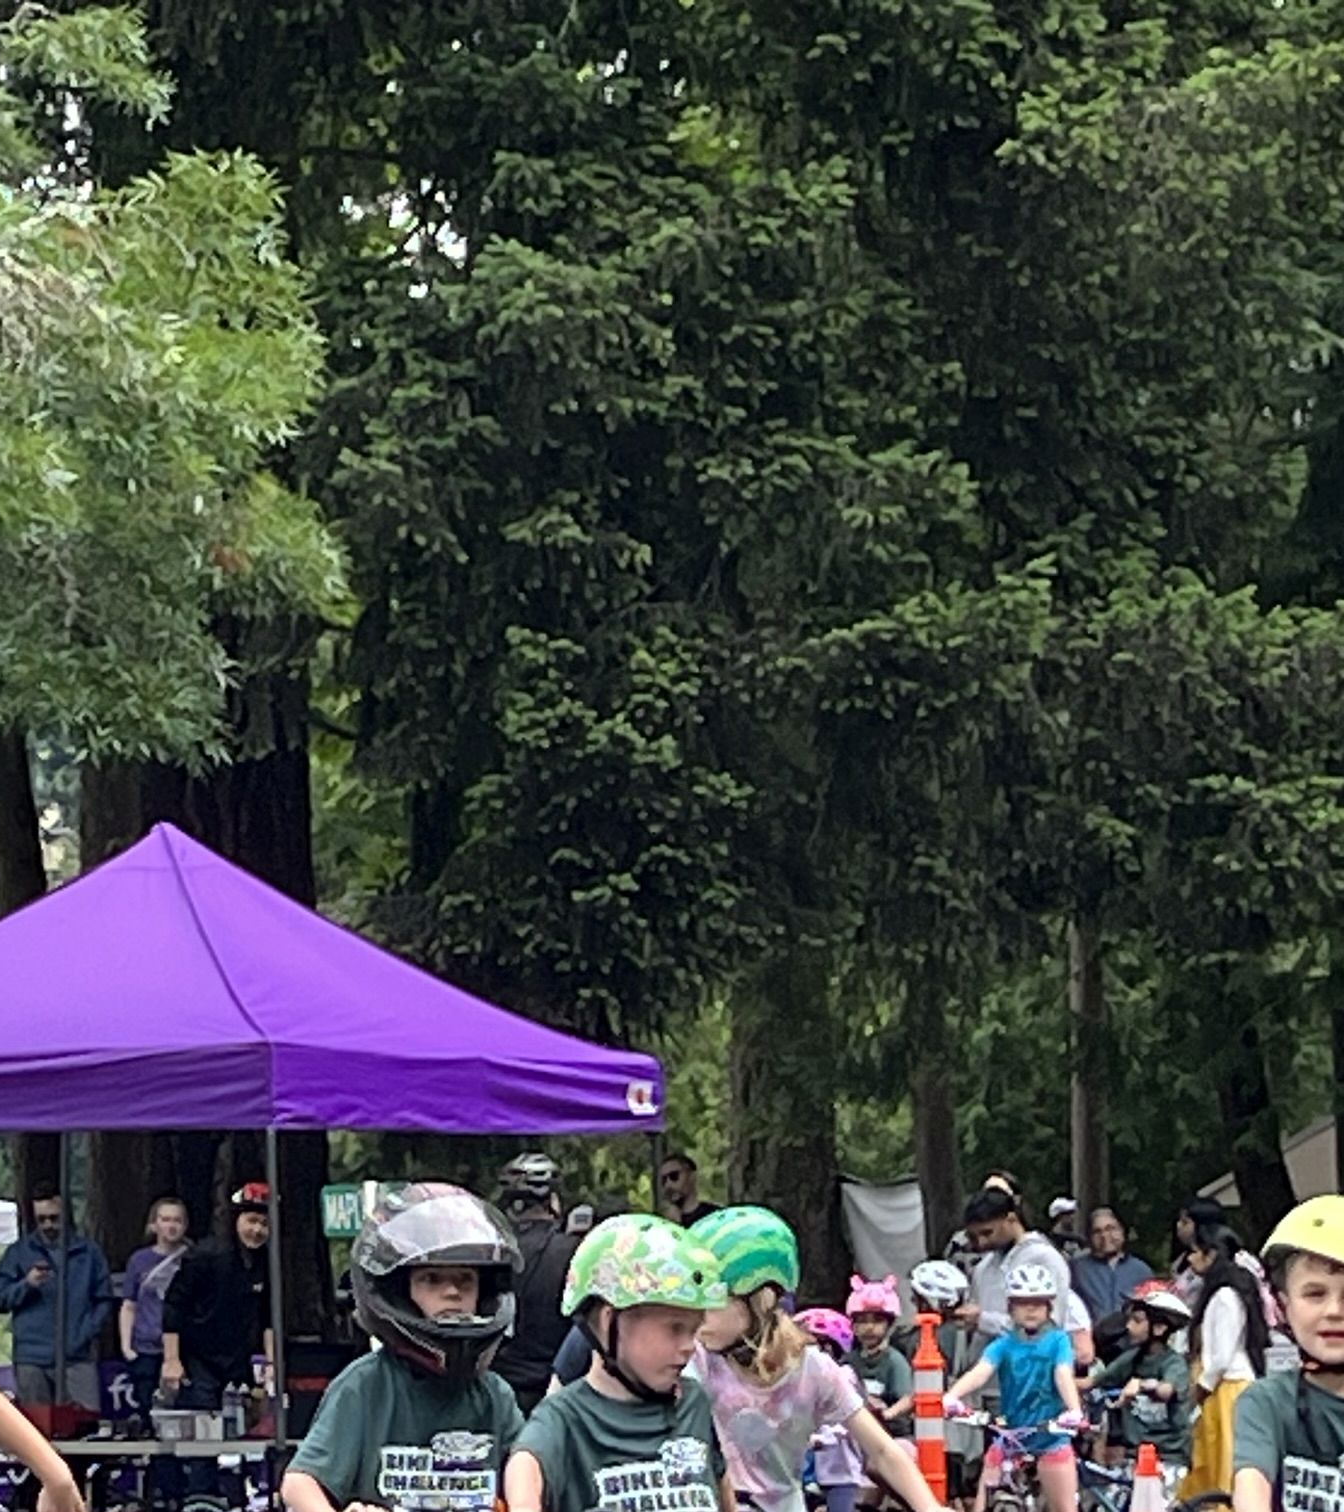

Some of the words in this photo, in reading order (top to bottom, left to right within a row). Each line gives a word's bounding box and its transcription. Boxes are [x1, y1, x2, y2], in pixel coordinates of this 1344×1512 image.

[324, 1192, 363, 1231] MAPL
[602, 1468, 666, 1497] BIKE
[1283, 1463, 1338, 1495] BIKE
